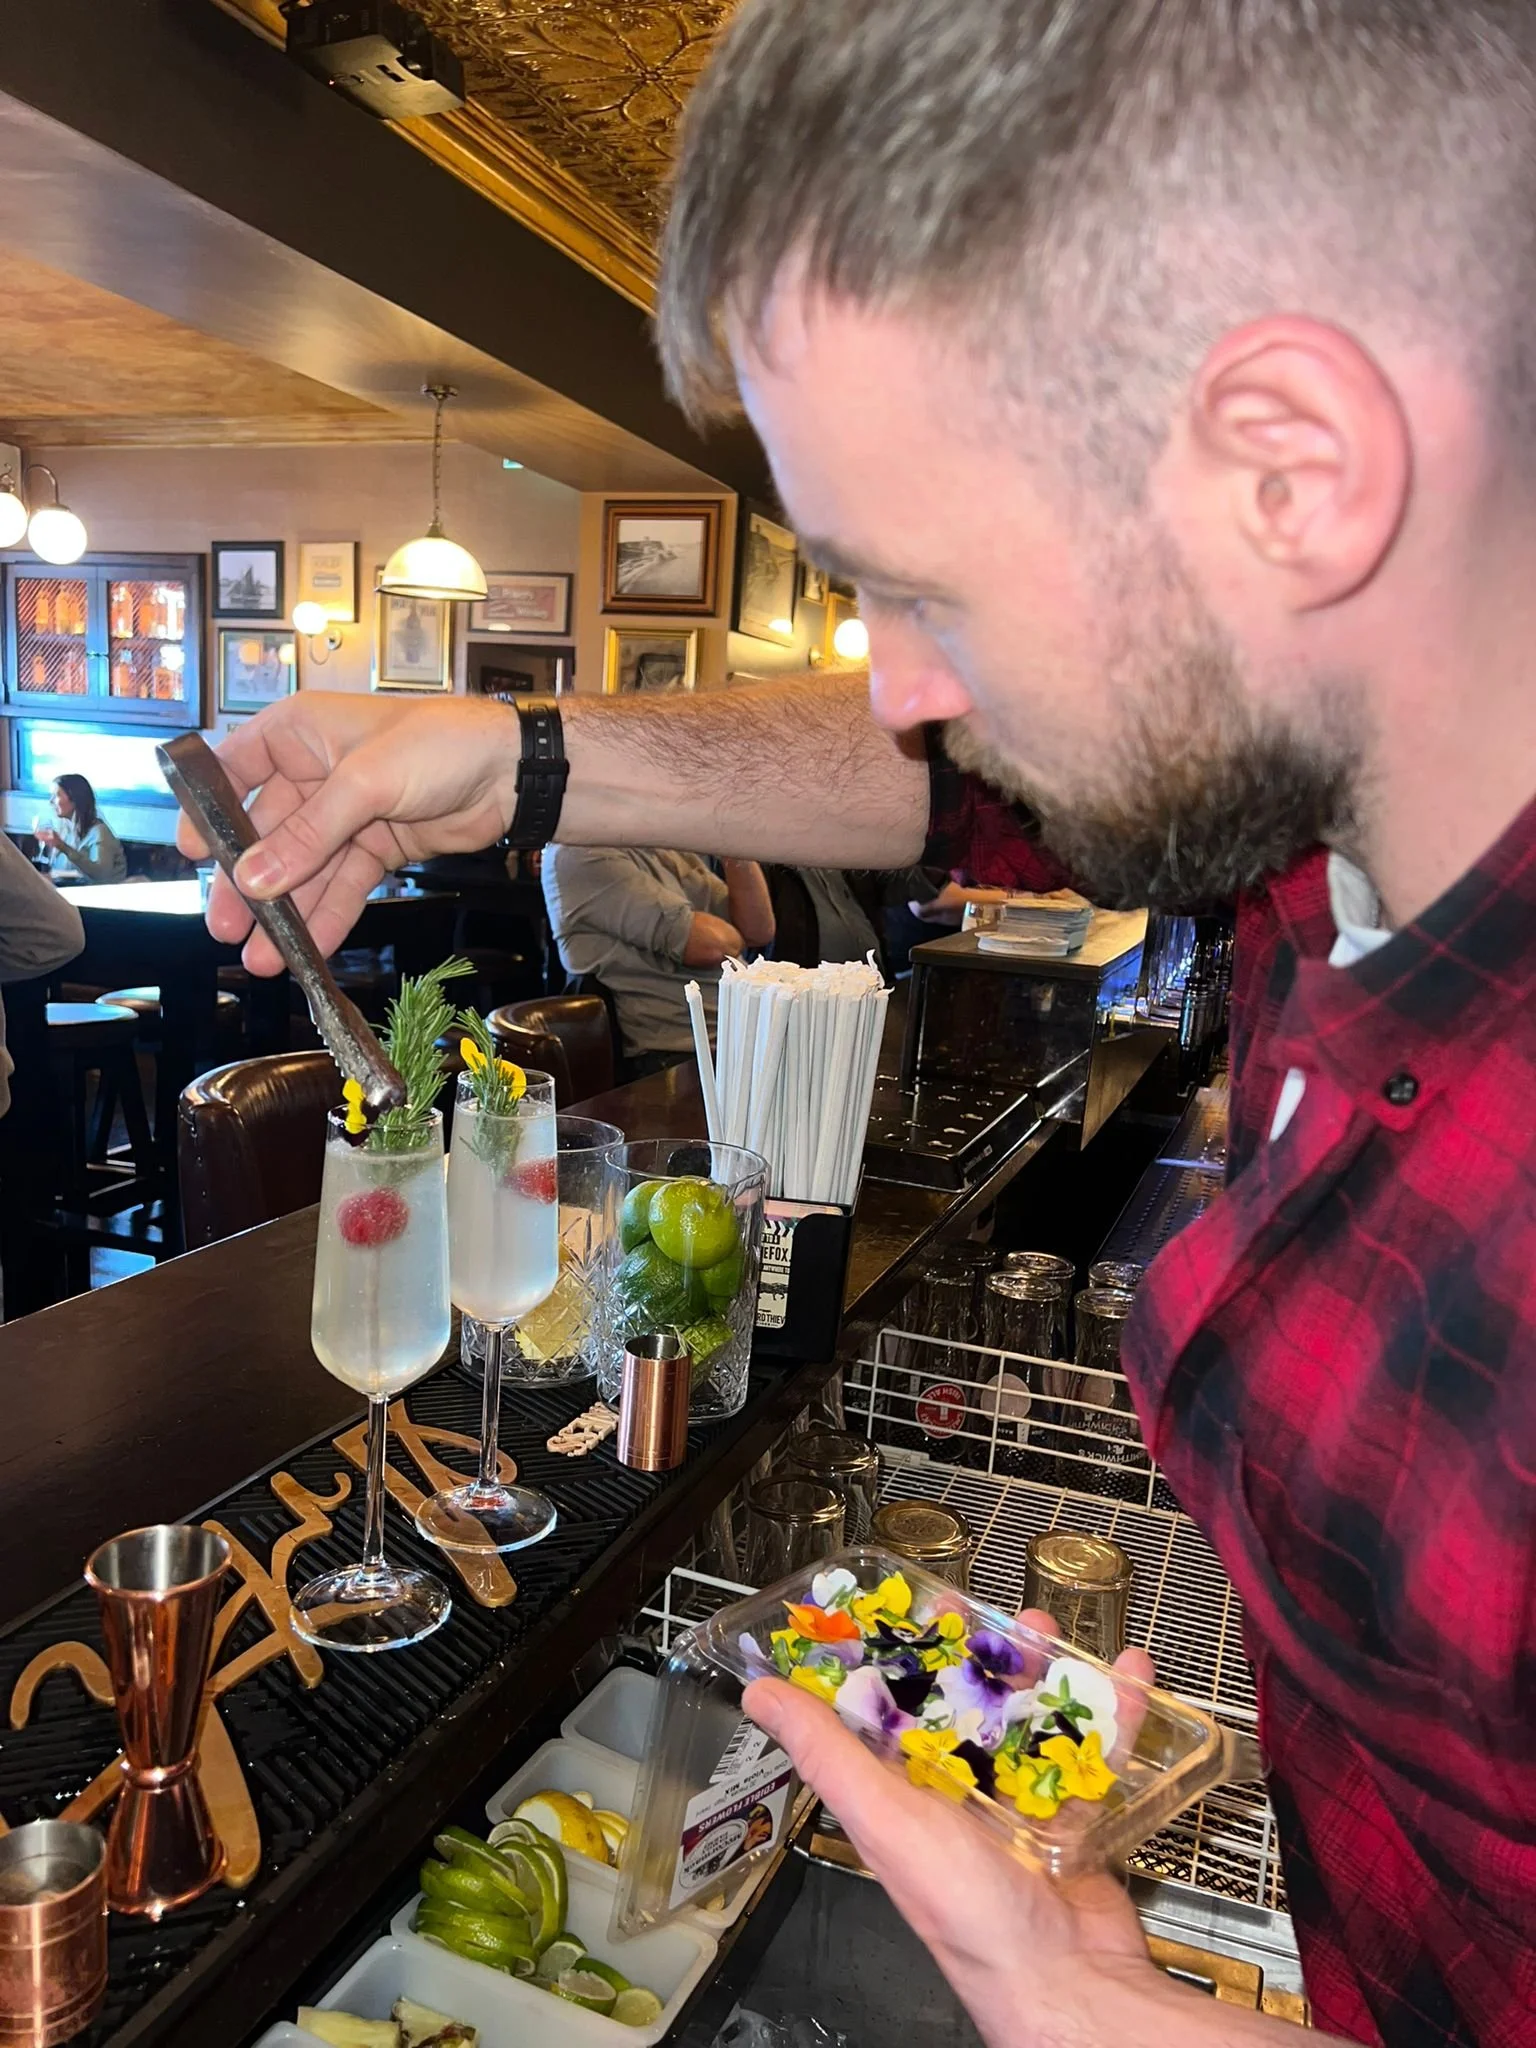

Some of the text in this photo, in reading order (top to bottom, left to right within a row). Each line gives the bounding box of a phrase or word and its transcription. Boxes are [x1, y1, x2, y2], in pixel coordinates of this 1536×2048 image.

[1078, 1449, 1146, 1464] SMITHWICKS
[743, 1782, 776, 1805] EDIBLE
[698, 1801, 742, 1832] FLOWERS
